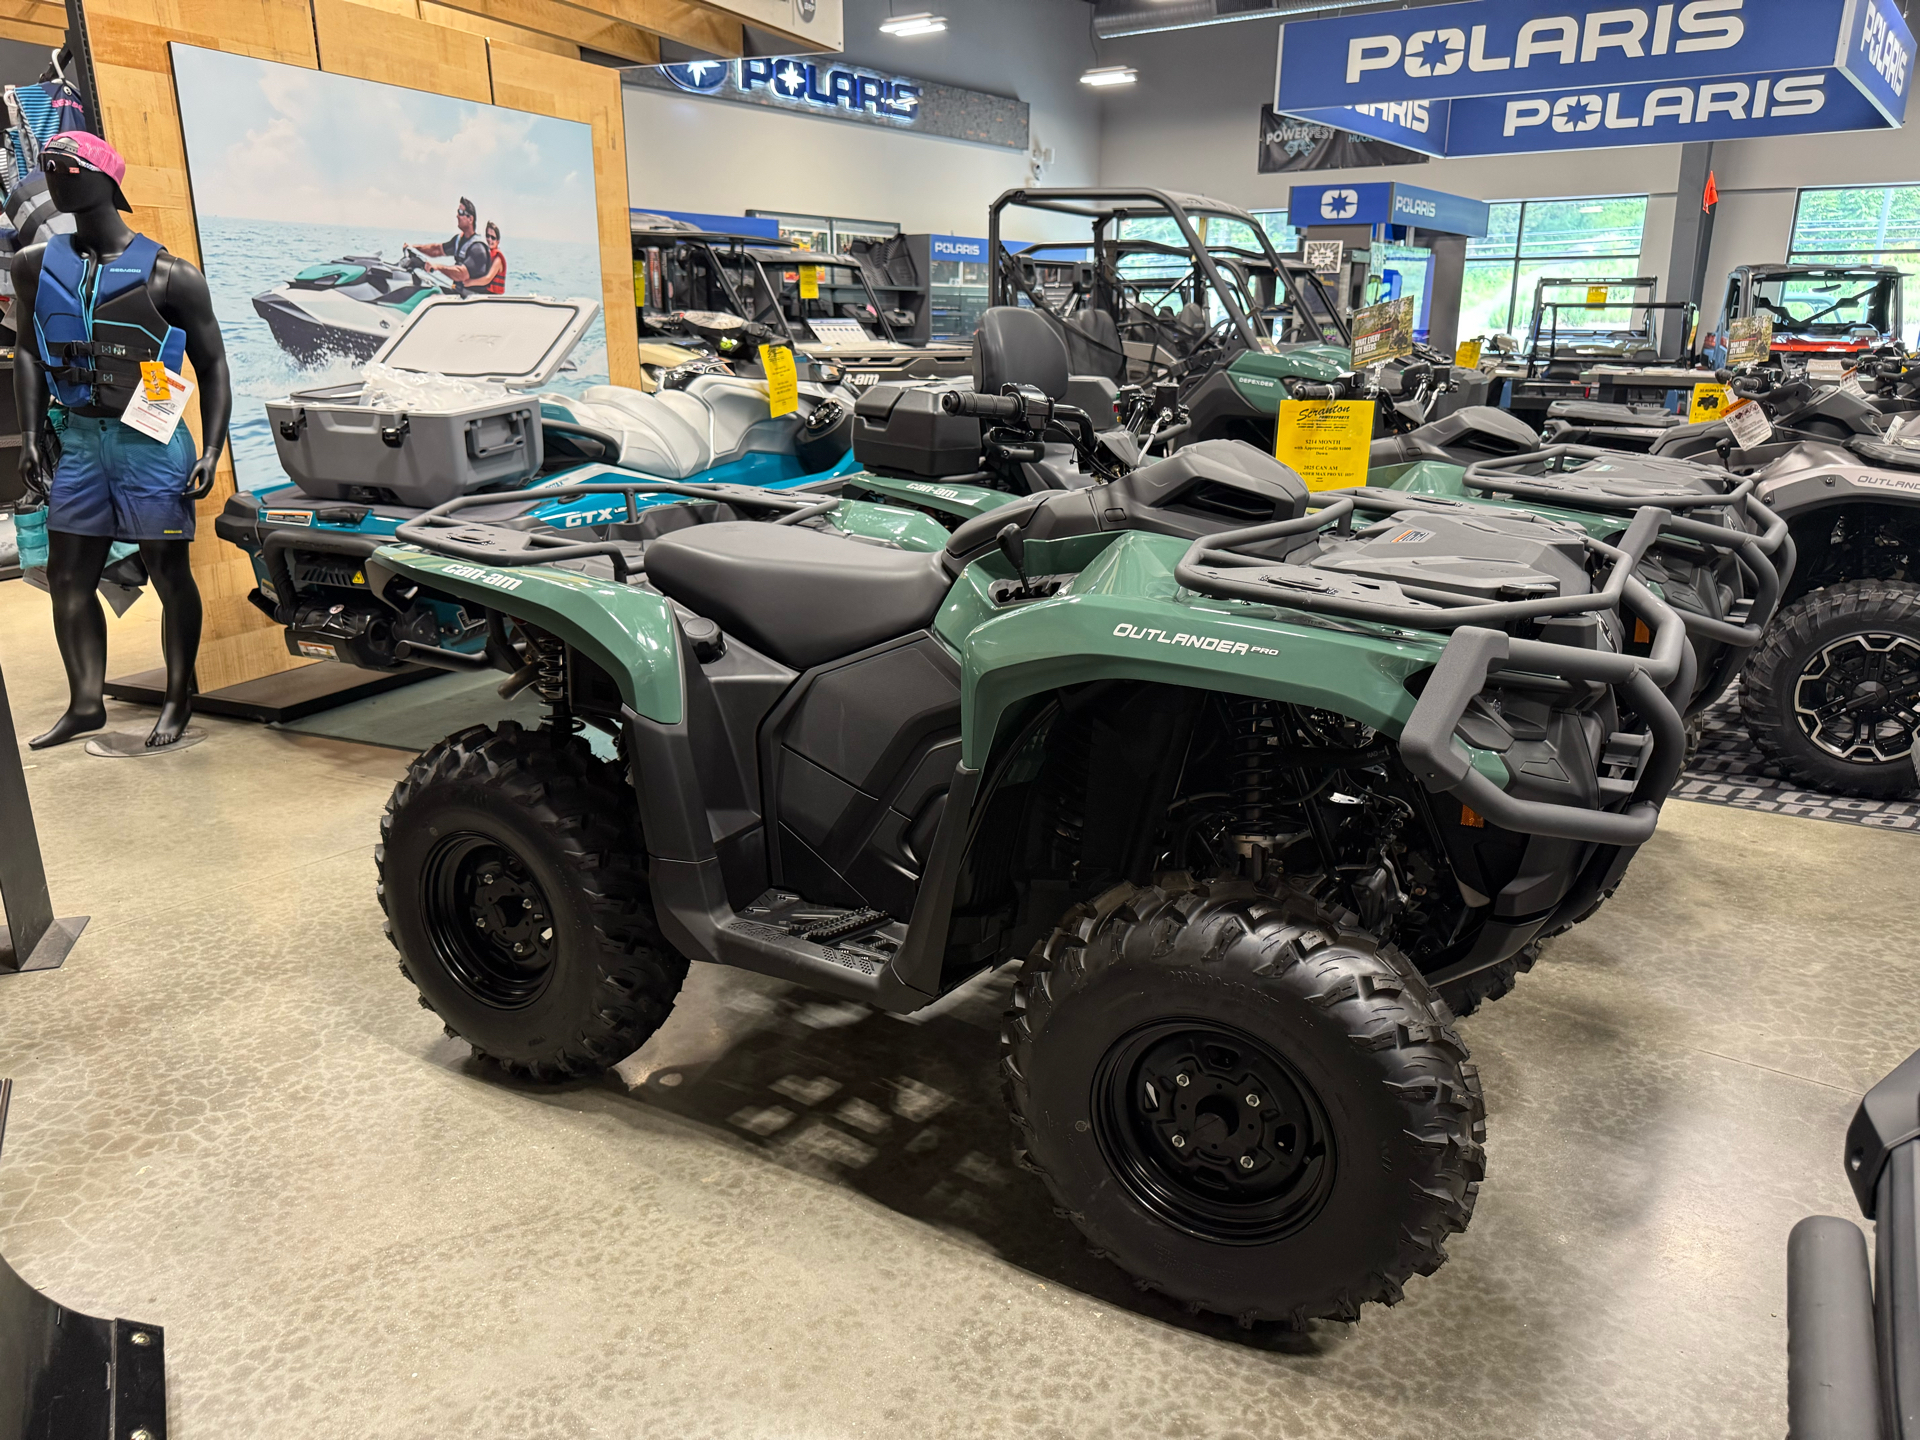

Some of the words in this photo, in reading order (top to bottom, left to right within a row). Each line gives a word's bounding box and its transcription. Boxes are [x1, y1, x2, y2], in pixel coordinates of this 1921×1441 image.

[1346, 0, 1744, 84] POLARIS
[1860, 0, 1908, 97] POLARIS
[737, 57, 921, 121] POLARIS
[1503, 75, 1826, 137] POLARIS
[1266, 123, 1336, 146] POWERFEST
[1395, 196, 1436, 218] POLARIS
[935, 242, 980, 256] POLARIS
[1354, 347, 1363, 356] ATV
[1363, 343, 1377, 355] NEEDS
[1355, 337, 1367, 348] WHAT
[1367, 333, 1381, 344] EVERY
[843, 373, 880, 386] n-am
[1238, 377, 1275, 388] DEFENDER
[1296, 405, 1351, 421] Scranton
[905, 482, 959, 499] can-am
[565, 507, 613, 528] GTX
[441, 564, 523, 591] can-am
[1112, 623, 1250, 656] OUTLANDER
[1250, 646, 1280, 656] PRO
